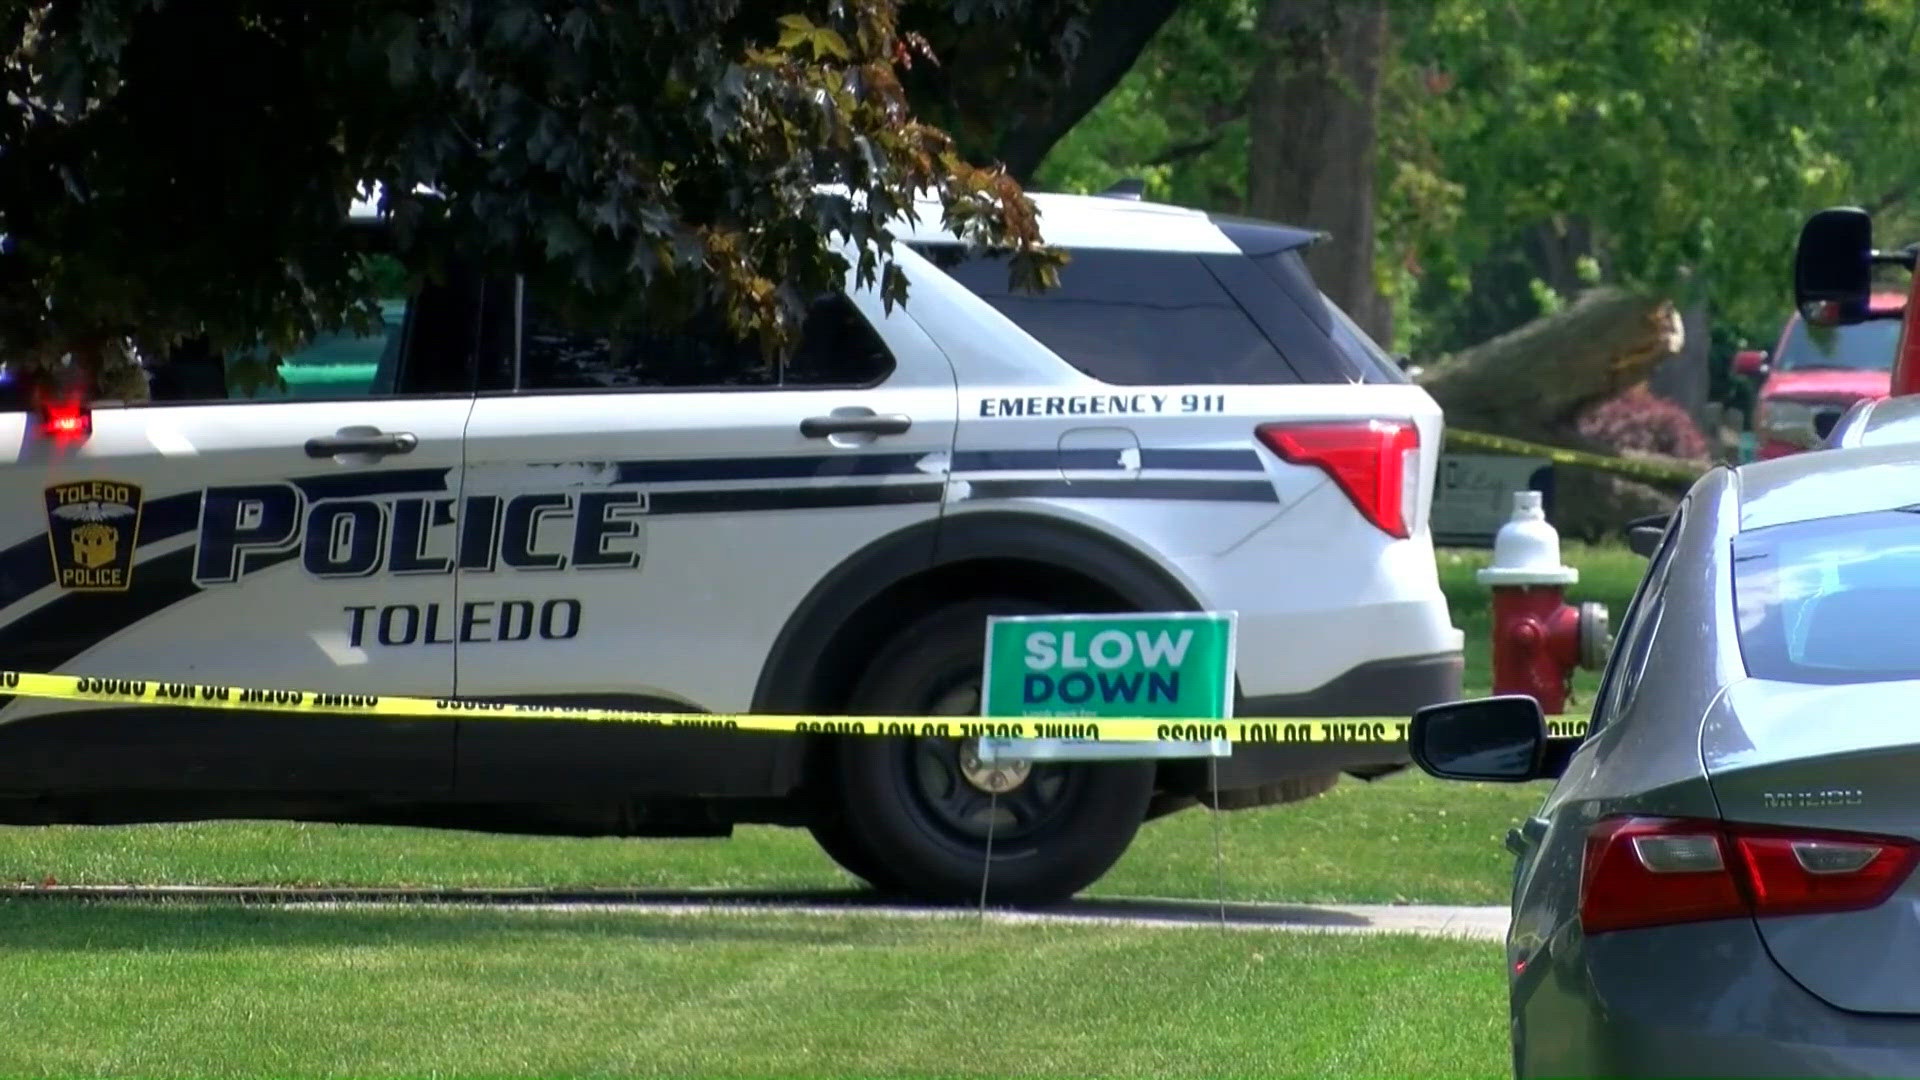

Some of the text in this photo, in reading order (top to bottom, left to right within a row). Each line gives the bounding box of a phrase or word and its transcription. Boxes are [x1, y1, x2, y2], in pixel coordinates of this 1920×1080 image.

[979, 394, 1225, 417] EMERGENCY 911
[56, 483, 129, 504] TOLEDO
[193, 481, 650, 589] POLICE
[62, 568, 121, 586] POLICE
[344, 598, 583, 648] TOLEDO
[1023, 629, 1194, 670] SLOW
[1023, 671, 1180, 705] DOWN
